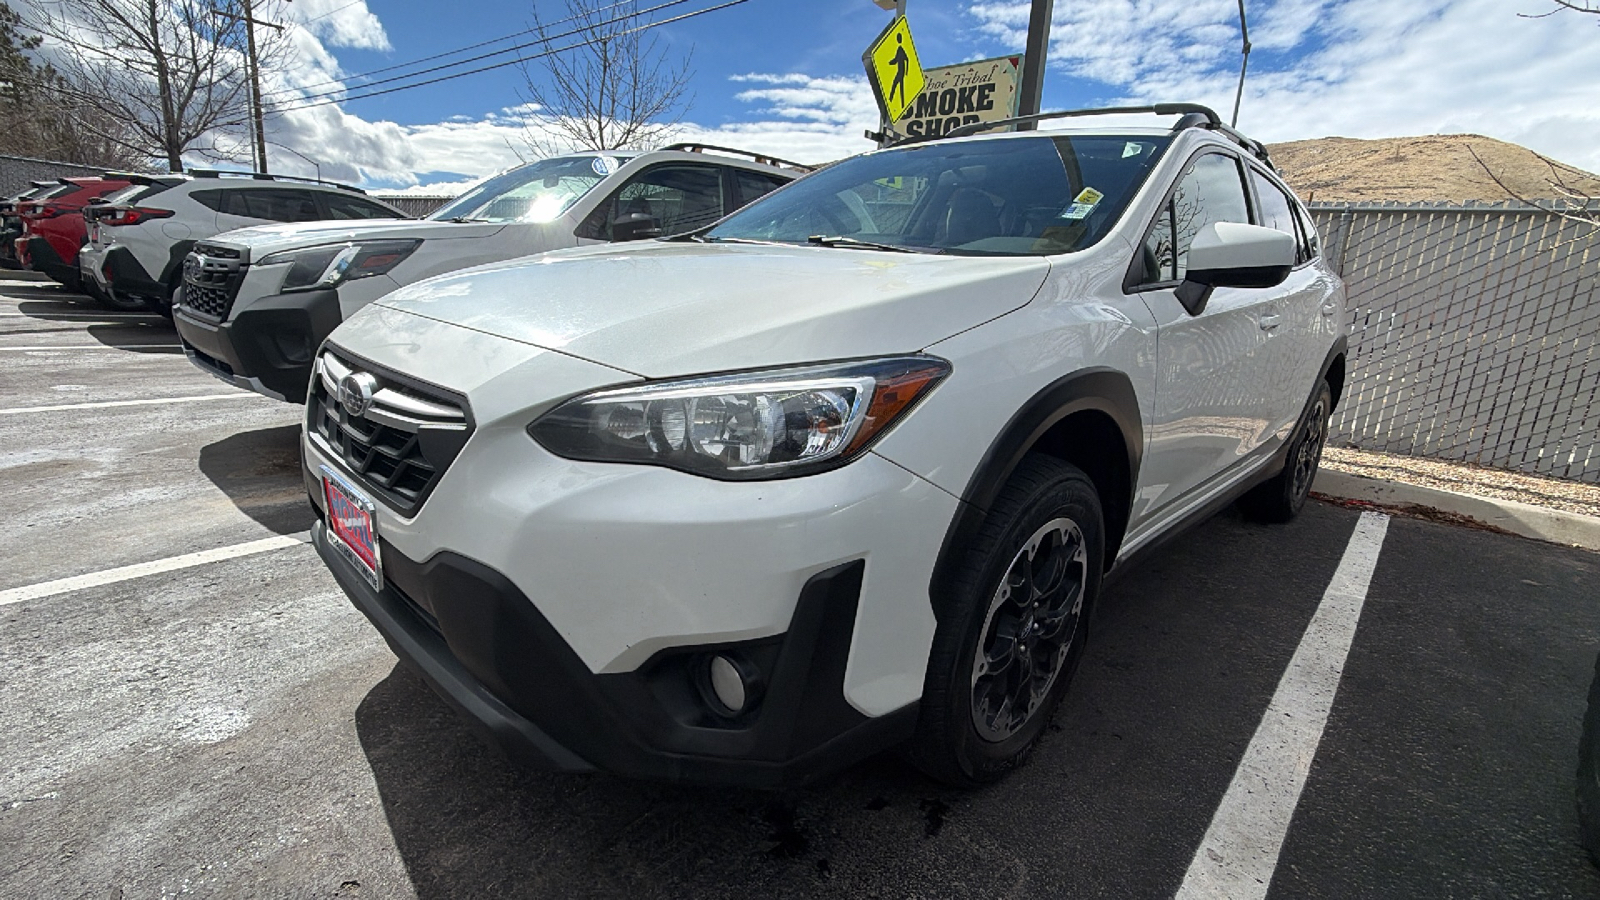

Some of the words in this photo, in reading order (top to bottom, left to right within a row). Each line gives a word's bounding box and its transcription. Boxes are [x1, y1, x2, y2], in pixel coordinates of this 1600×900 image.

[926, 78, 948, 90] hoe
[953, 68, 996, 87] Tribal
[900, 83, 996, 120] MOKE
